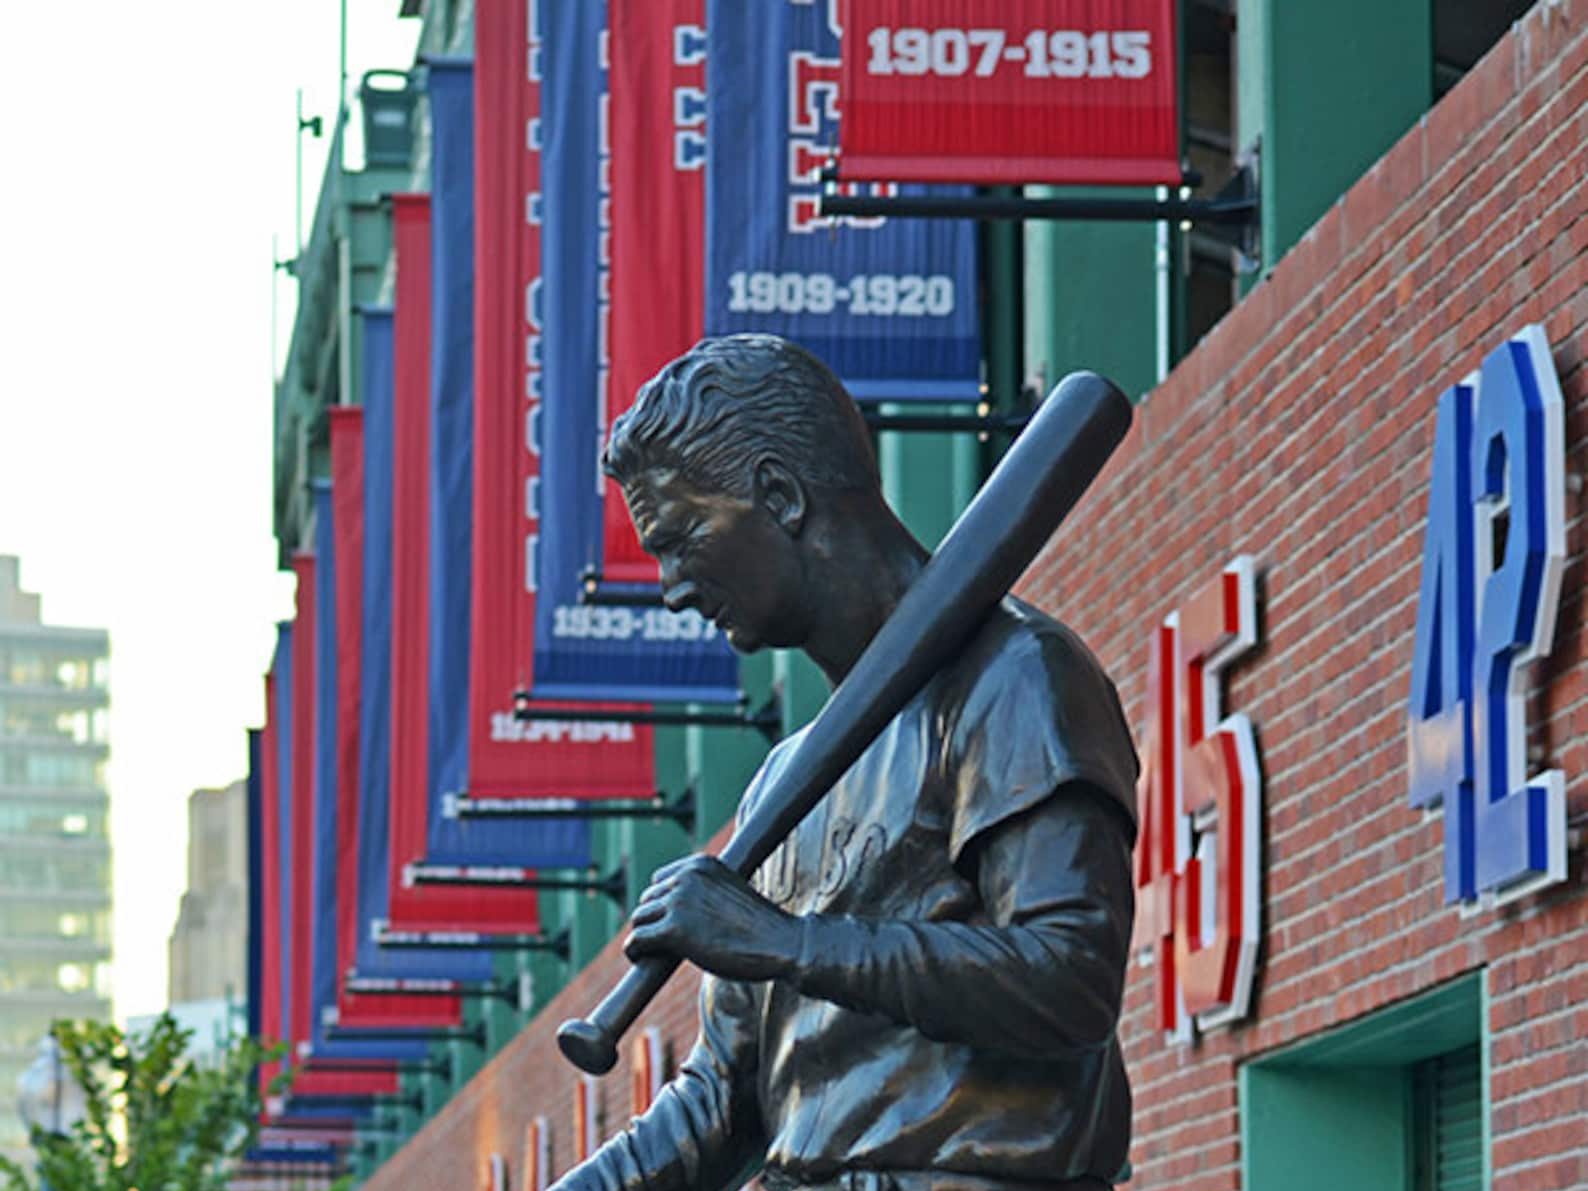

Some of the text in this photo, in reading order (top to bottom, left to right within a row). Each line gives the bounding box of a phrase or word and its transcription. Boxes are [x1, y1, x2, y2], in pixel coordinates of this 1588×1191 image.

[867, 26, 1152, 79] 1907-1915
[728, 271, 954, 317] 1909-1920
[1408, 323, 1567, 917] 42
[1134, 554, 1261, 1046] 45
